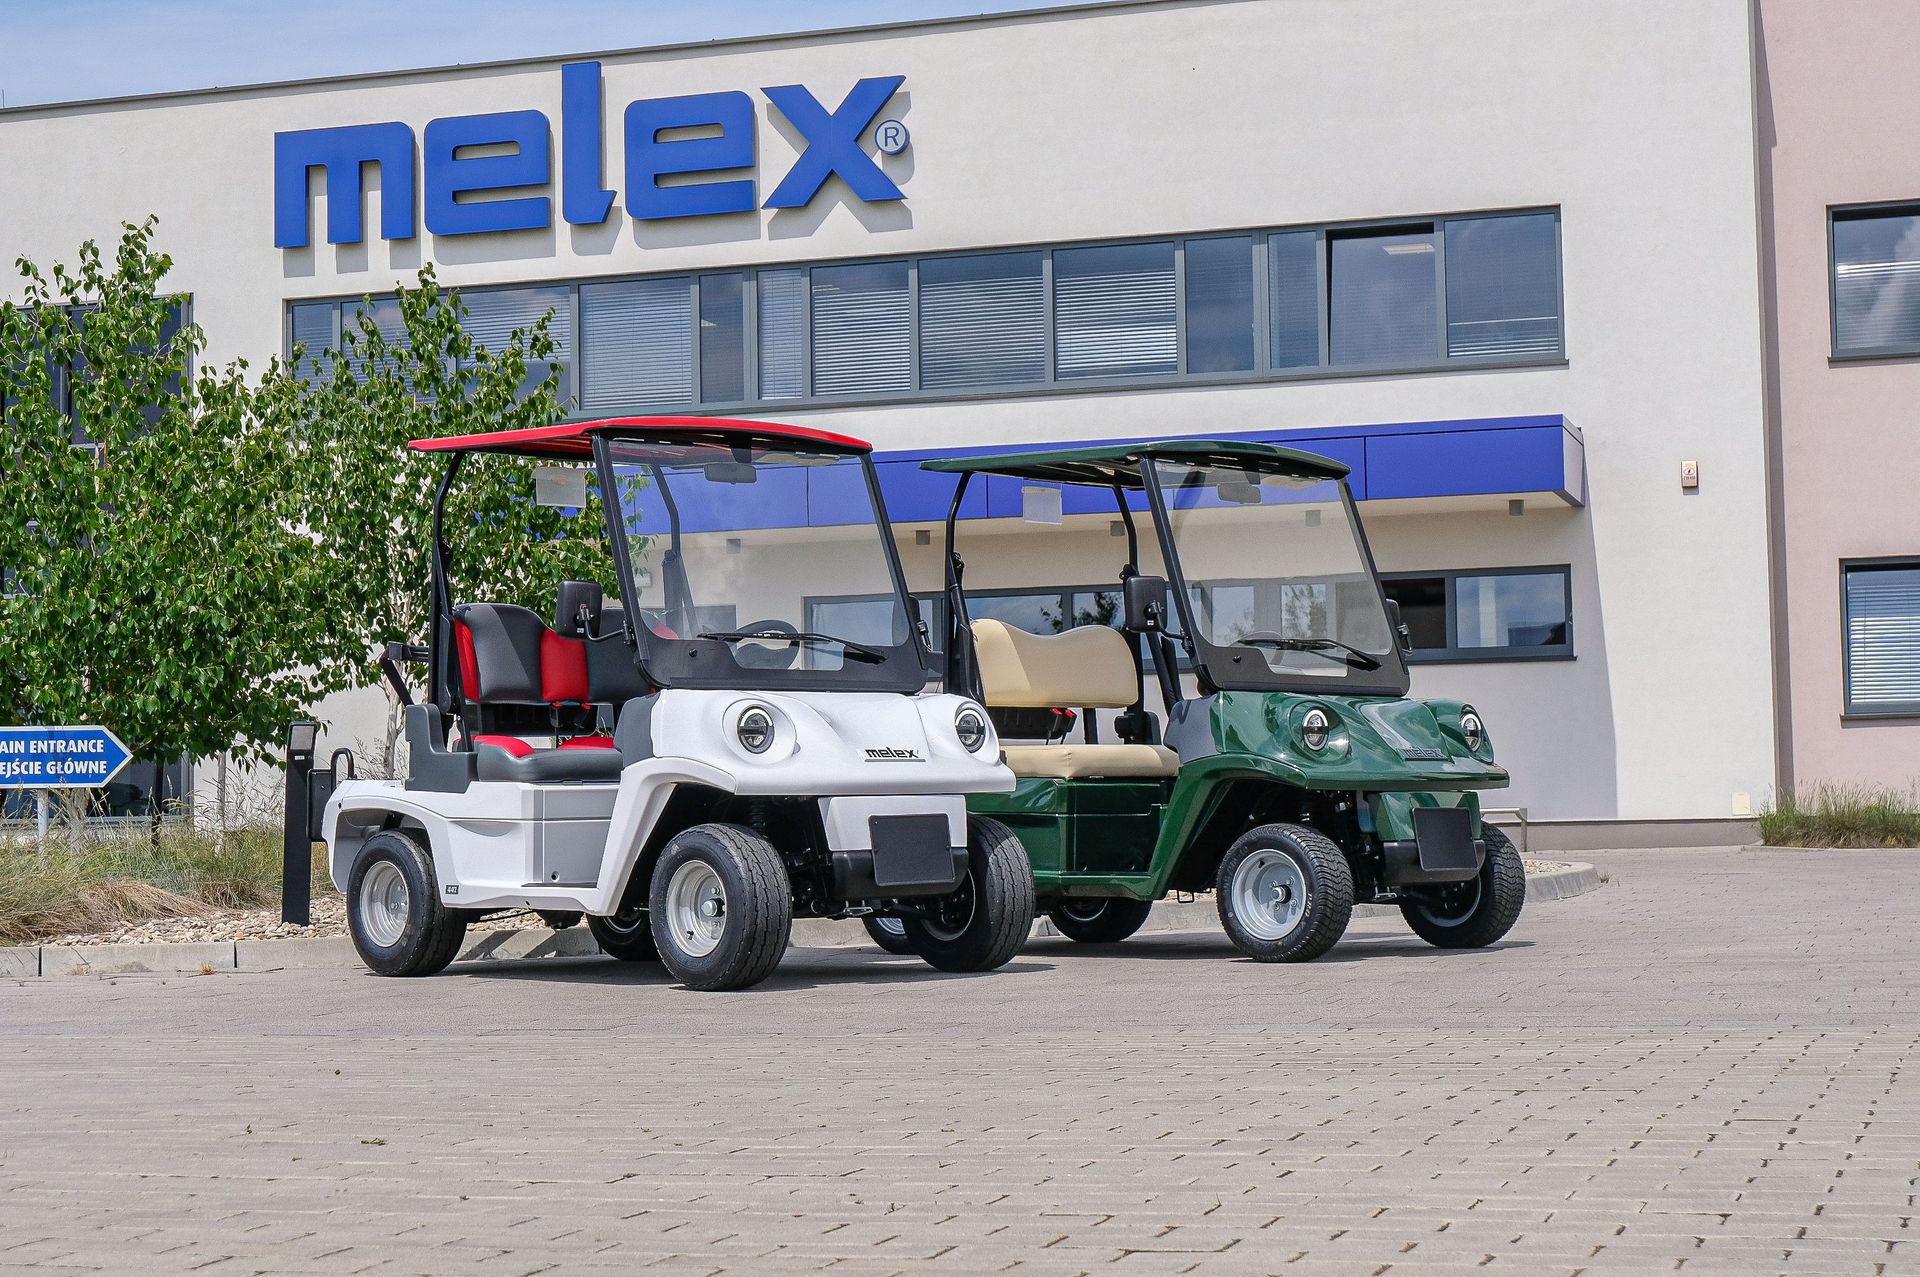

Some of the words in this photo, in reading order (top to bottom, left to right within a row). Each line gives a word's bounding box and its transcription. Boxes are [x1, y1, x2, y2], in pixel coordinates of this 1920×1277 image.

[274, 61, 907, 249] melex
[0, 740, 24, 753] AIN
[30, 740, 104, 753] ENTRANCE
[865, 747, 918, 758] melex
[0, 758, 41, 778] EJŚCIE
[46, 758, 107, 774] GŁÓWNE
